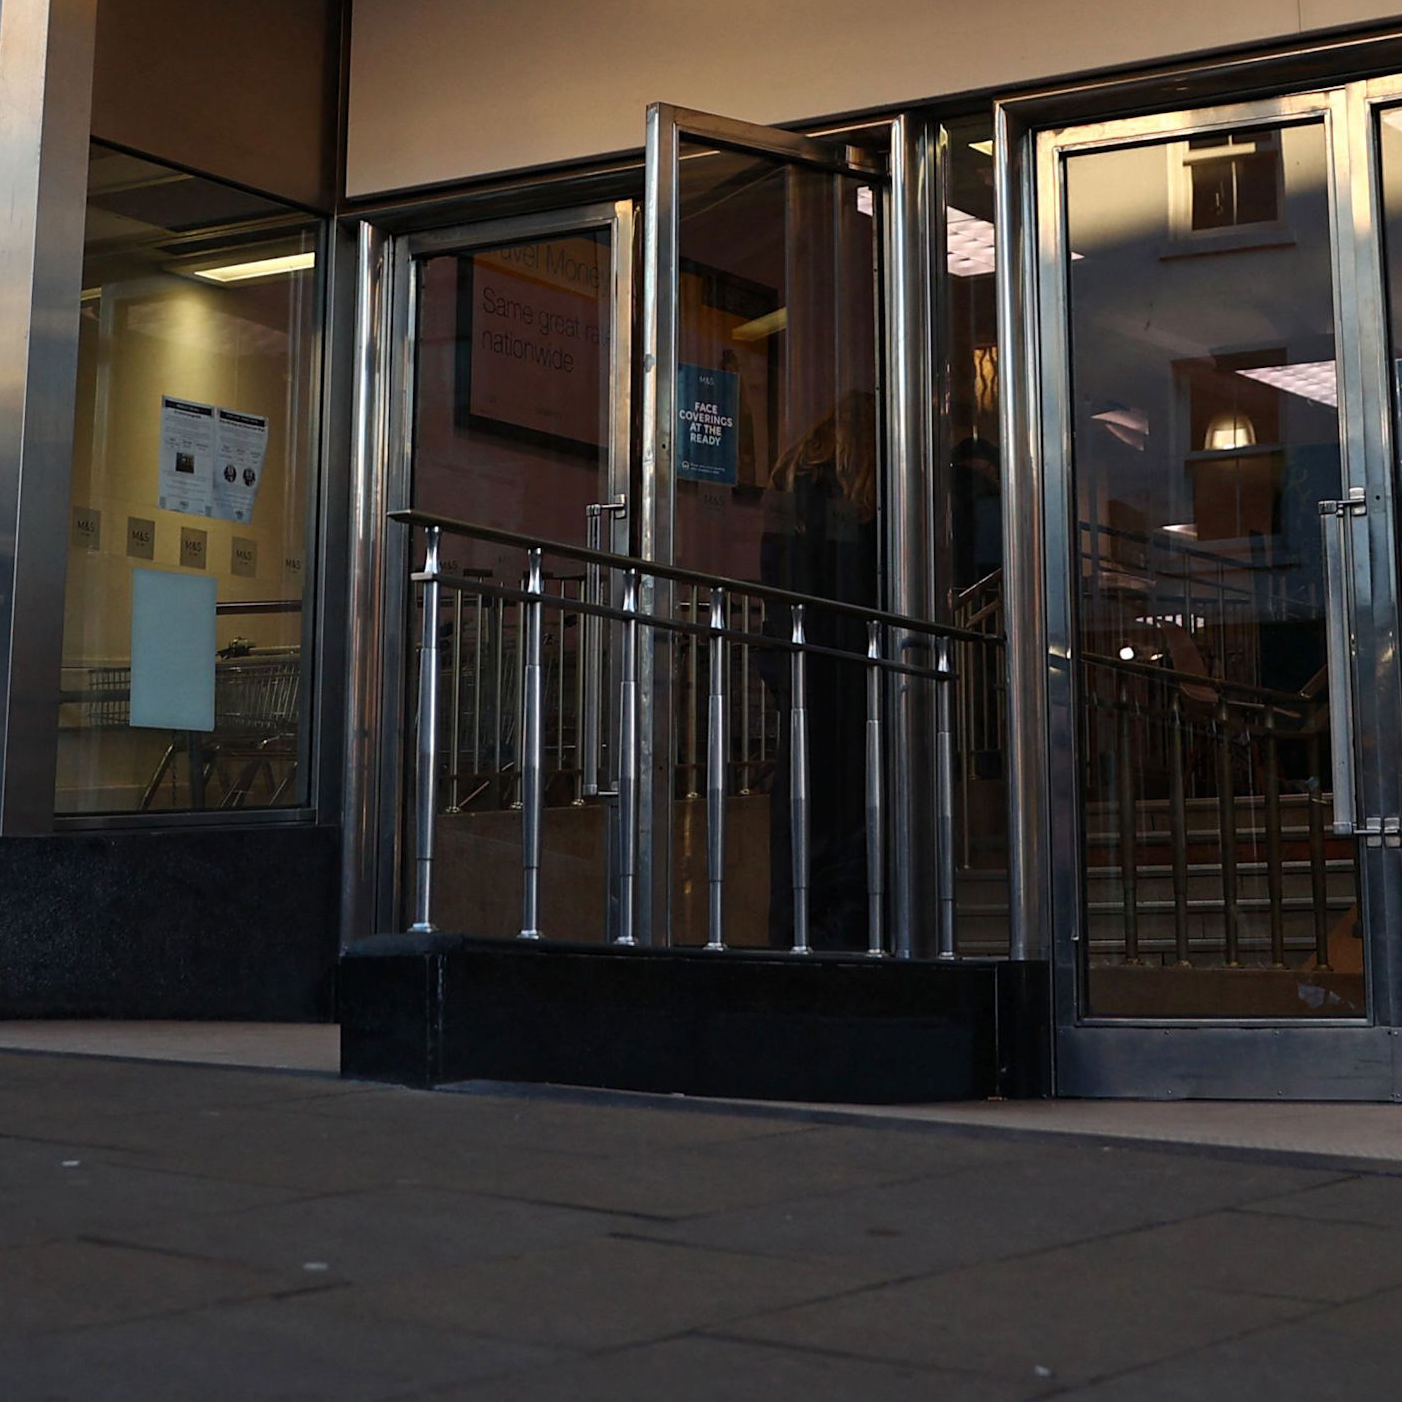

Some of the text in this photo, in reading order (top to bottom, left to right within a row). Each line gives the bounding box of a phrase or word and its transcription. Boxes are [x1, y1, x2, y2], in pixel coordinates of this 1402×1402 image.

[492, 244, 540, 270] avel
[482, 286, 535, 325] Same
[538, 309, 581, 340] great
[481, 327, 574, 374] nationwide
[698, 375, 715, 386] M&S
[694, 401, 719, 415] FACE
[679, 409, 733, 427] COVERINGS
[689, 423, 722, 437] AT THE
[689, 432, 721, 447] READY
[77, 520, 96, 533] M&S
[132, 529, 150, 543] M&S
[184, 540, 202, 553] M&S
[236, 549, 253, 562] M&S
[285, 557, 302, 570] M&S
